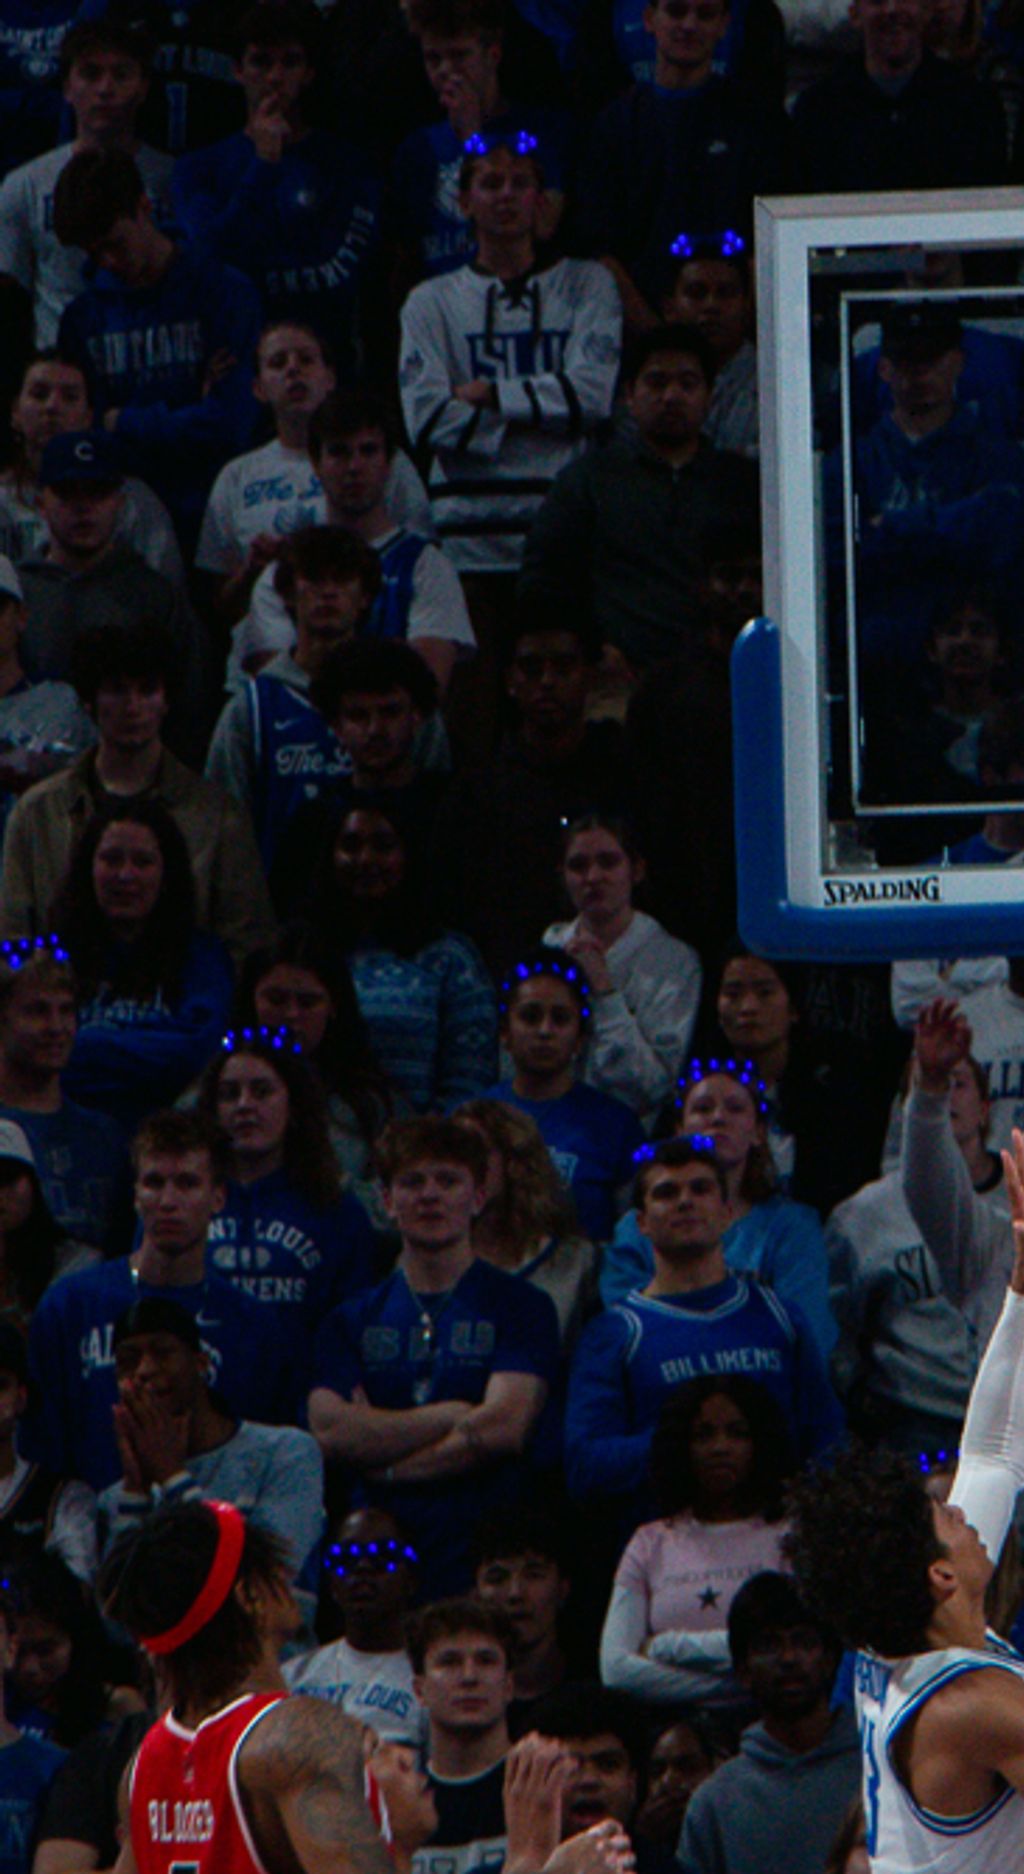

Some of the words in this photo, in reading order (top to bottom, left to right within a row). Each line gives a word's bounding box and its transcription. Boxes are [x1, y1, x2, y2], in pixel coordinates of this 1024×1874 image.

[275, 742, 326, 777] The
[823, 876, 941, 906] SPALDING
[253, 1218, 323, 1270] LOUIS
[659, 1346, 782, 1384] BILLIKENS
